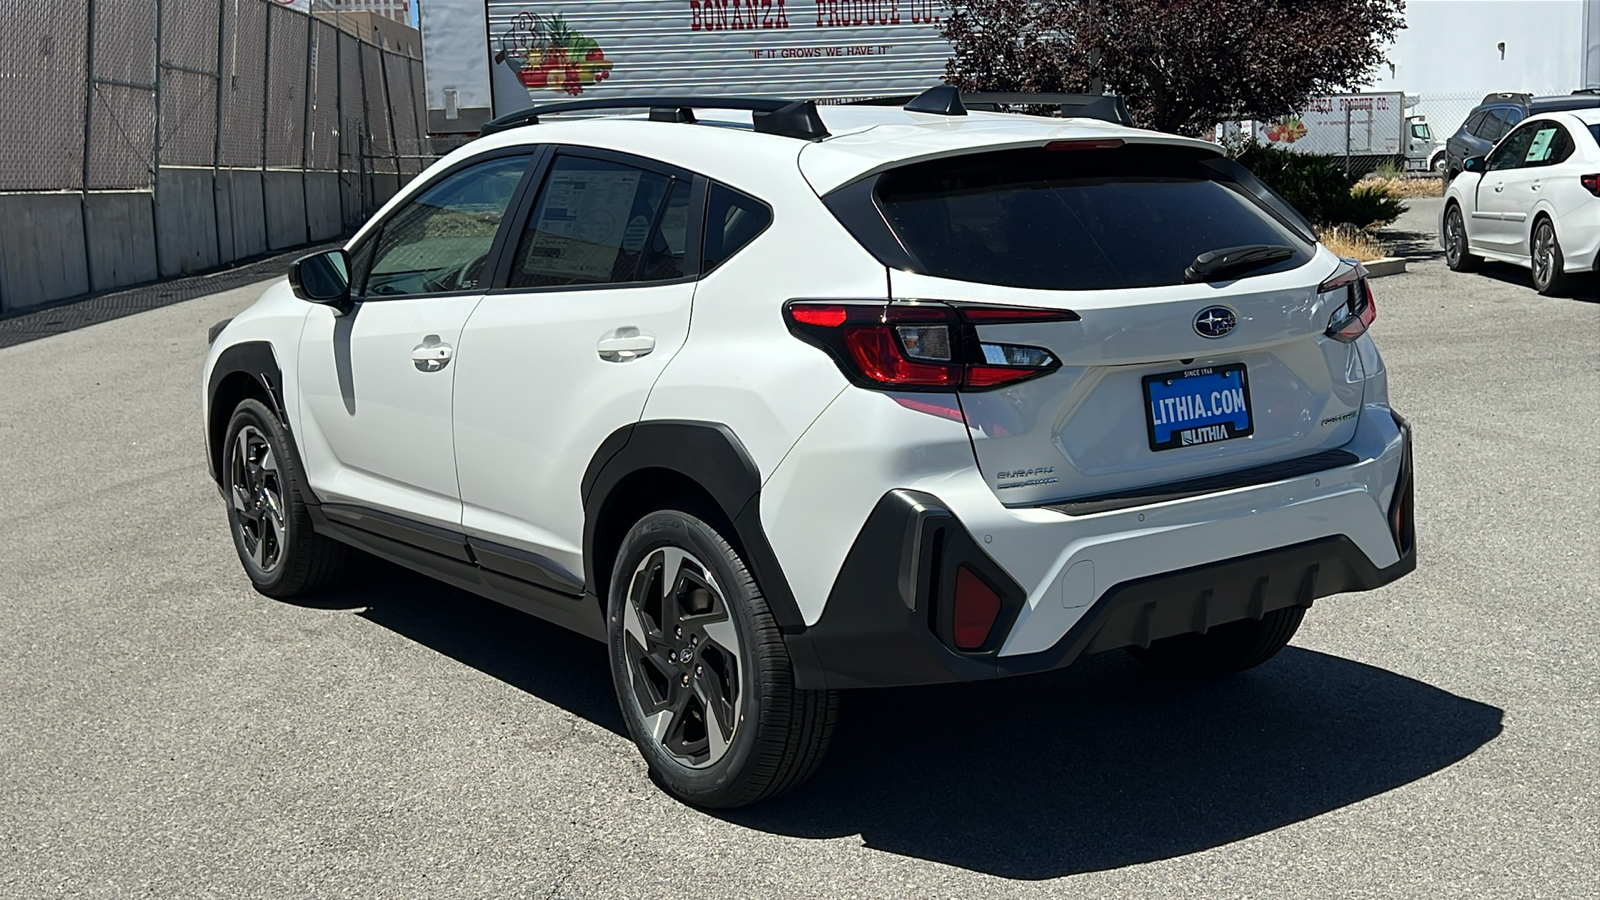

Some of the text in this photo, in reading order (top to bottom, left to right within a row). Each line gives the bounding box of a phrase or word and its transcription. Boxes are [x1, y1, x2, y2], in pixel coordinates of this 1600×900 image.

[690, 0, 940, 31] BONANZA PRODUCE CO.
[767, 49, 777, 58] IT
[780, 47, 821, 58] GROWS
[825, 47, 842, 57] WE
[846, 46, 874, 56] HAVE
[1184, 369, 1200, 378] SINCE
[1151, 387, 1247, 425] LITHIA.COM
[1191, 424, 1229, 444] LITHIA
